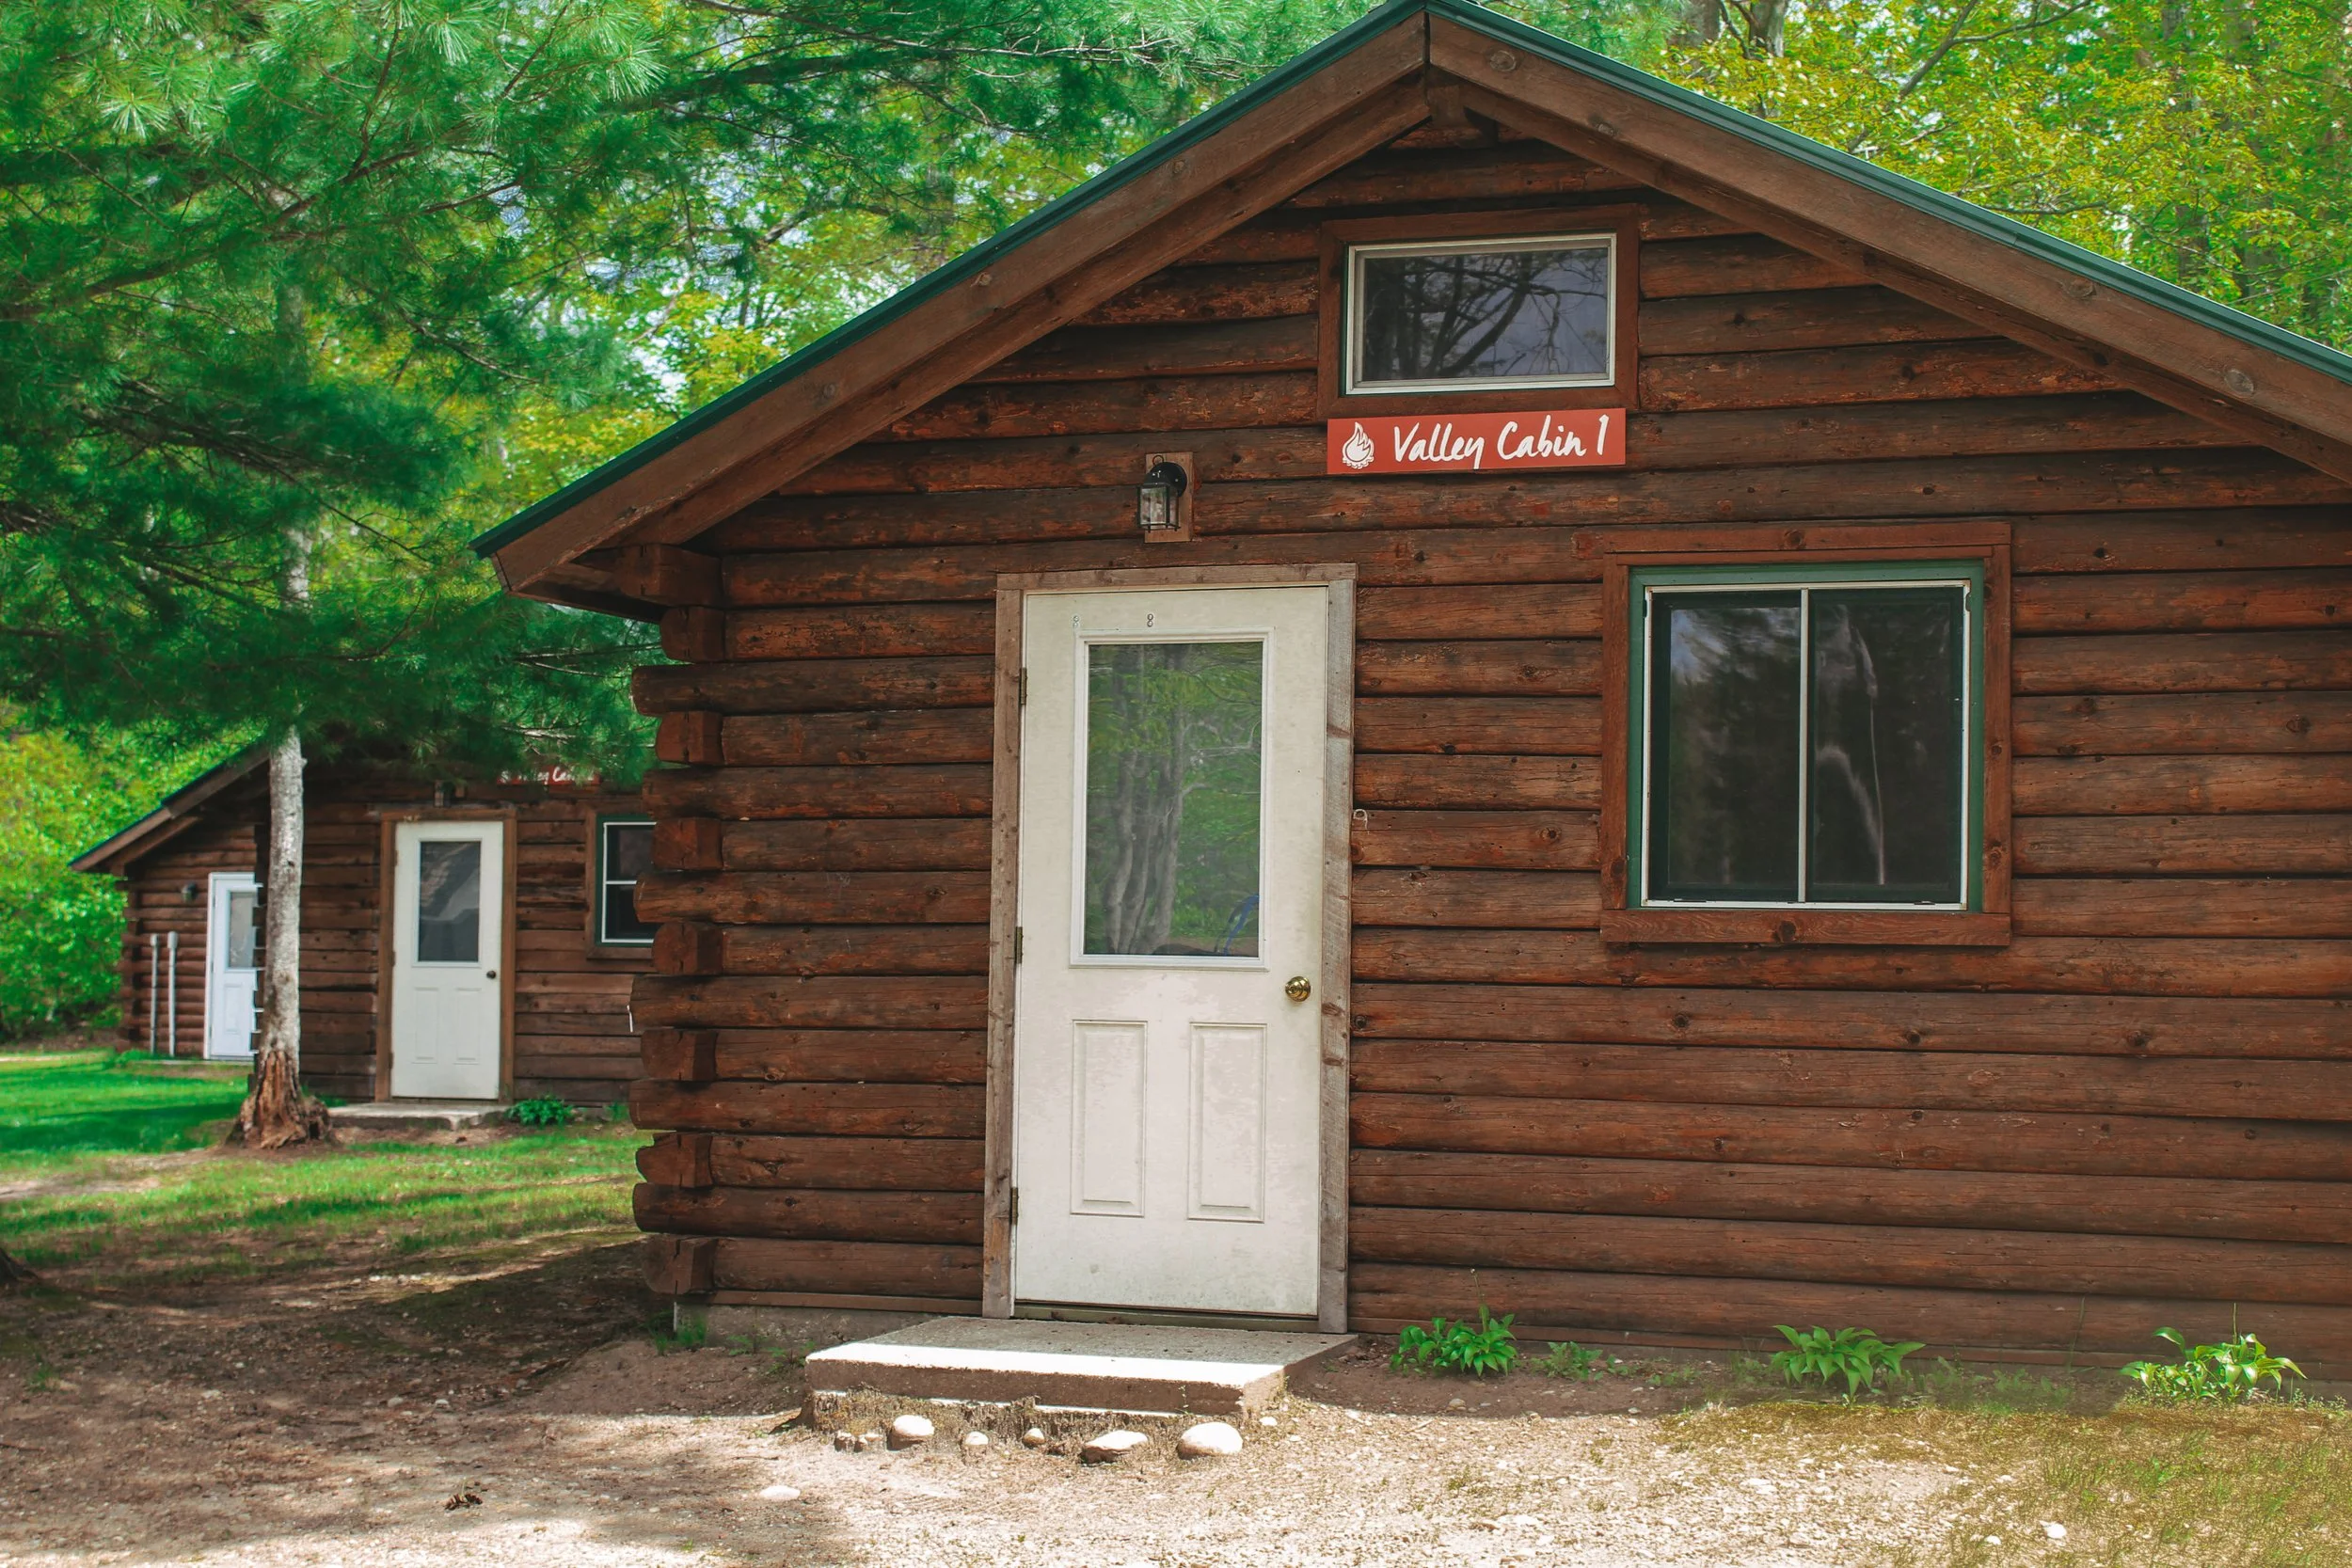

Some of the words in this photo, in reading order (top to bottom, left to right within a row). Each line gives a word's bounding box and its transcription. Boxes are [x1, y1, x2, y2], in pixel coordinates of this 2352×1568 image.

[1393, 421, 1486, 470] Valley
[1497, 414, 1587, 461] Cabin
[1597, 414, 1610, 456] 1
